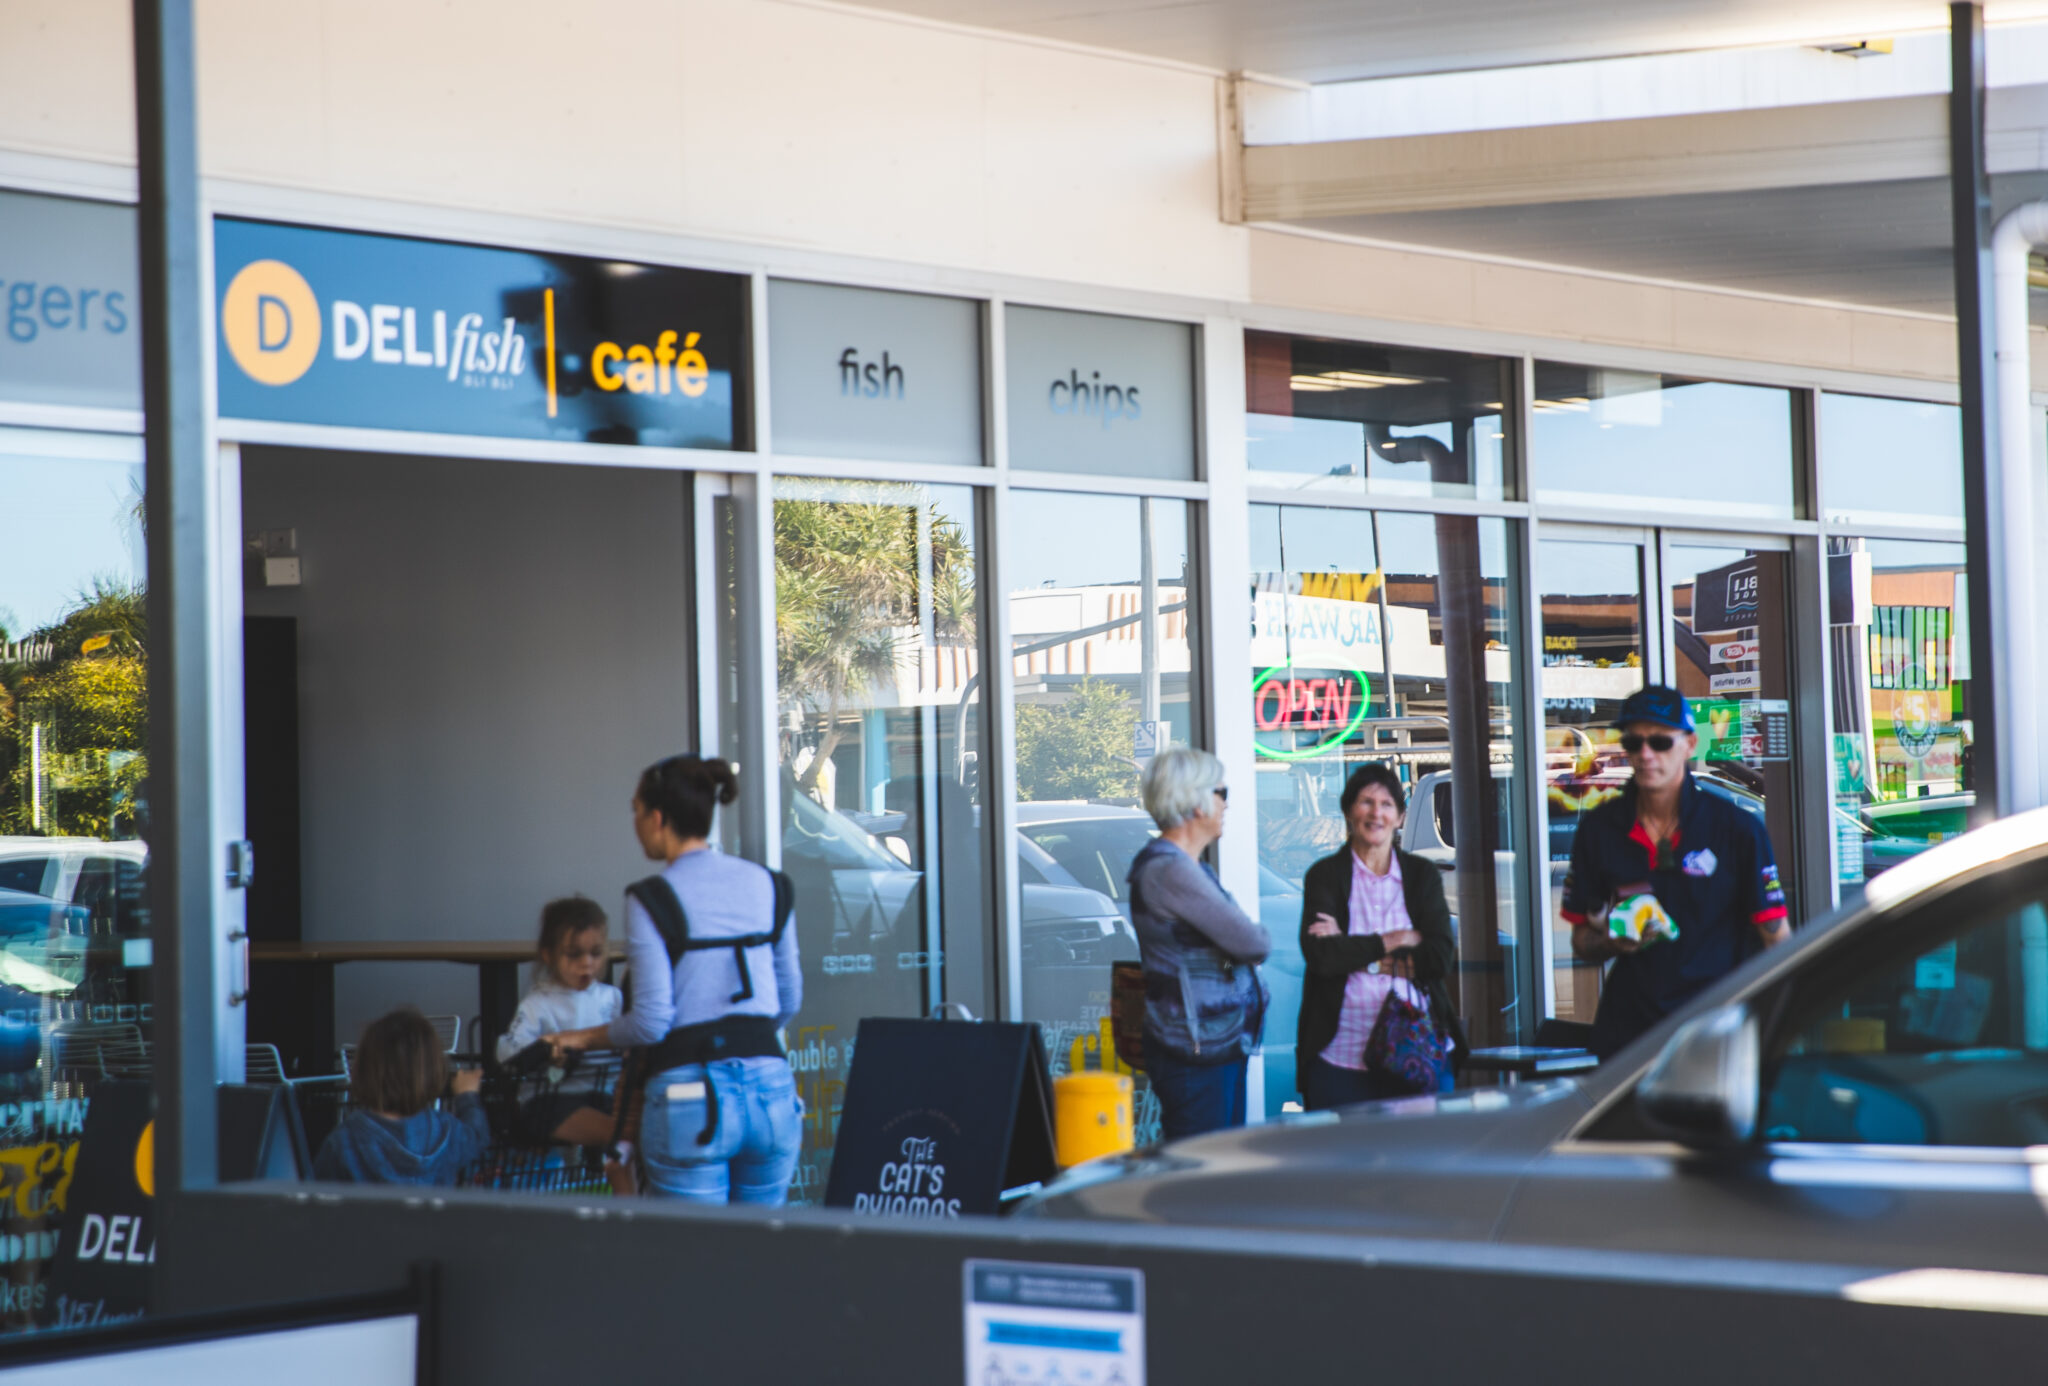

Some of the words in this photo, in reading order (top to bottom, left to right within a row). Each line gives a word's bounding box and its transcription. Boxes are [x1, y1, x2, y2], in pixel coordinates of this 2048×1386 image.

[0, 278, 129, 343] gers
[591, 329, 709, 397] café
[838, 346, 905, 401] fish
[1048, 368, 1142, 430] chips
[1255, 678, 1353, 731] OPEN
[879, 1161, 946, 1197] CAT'S
